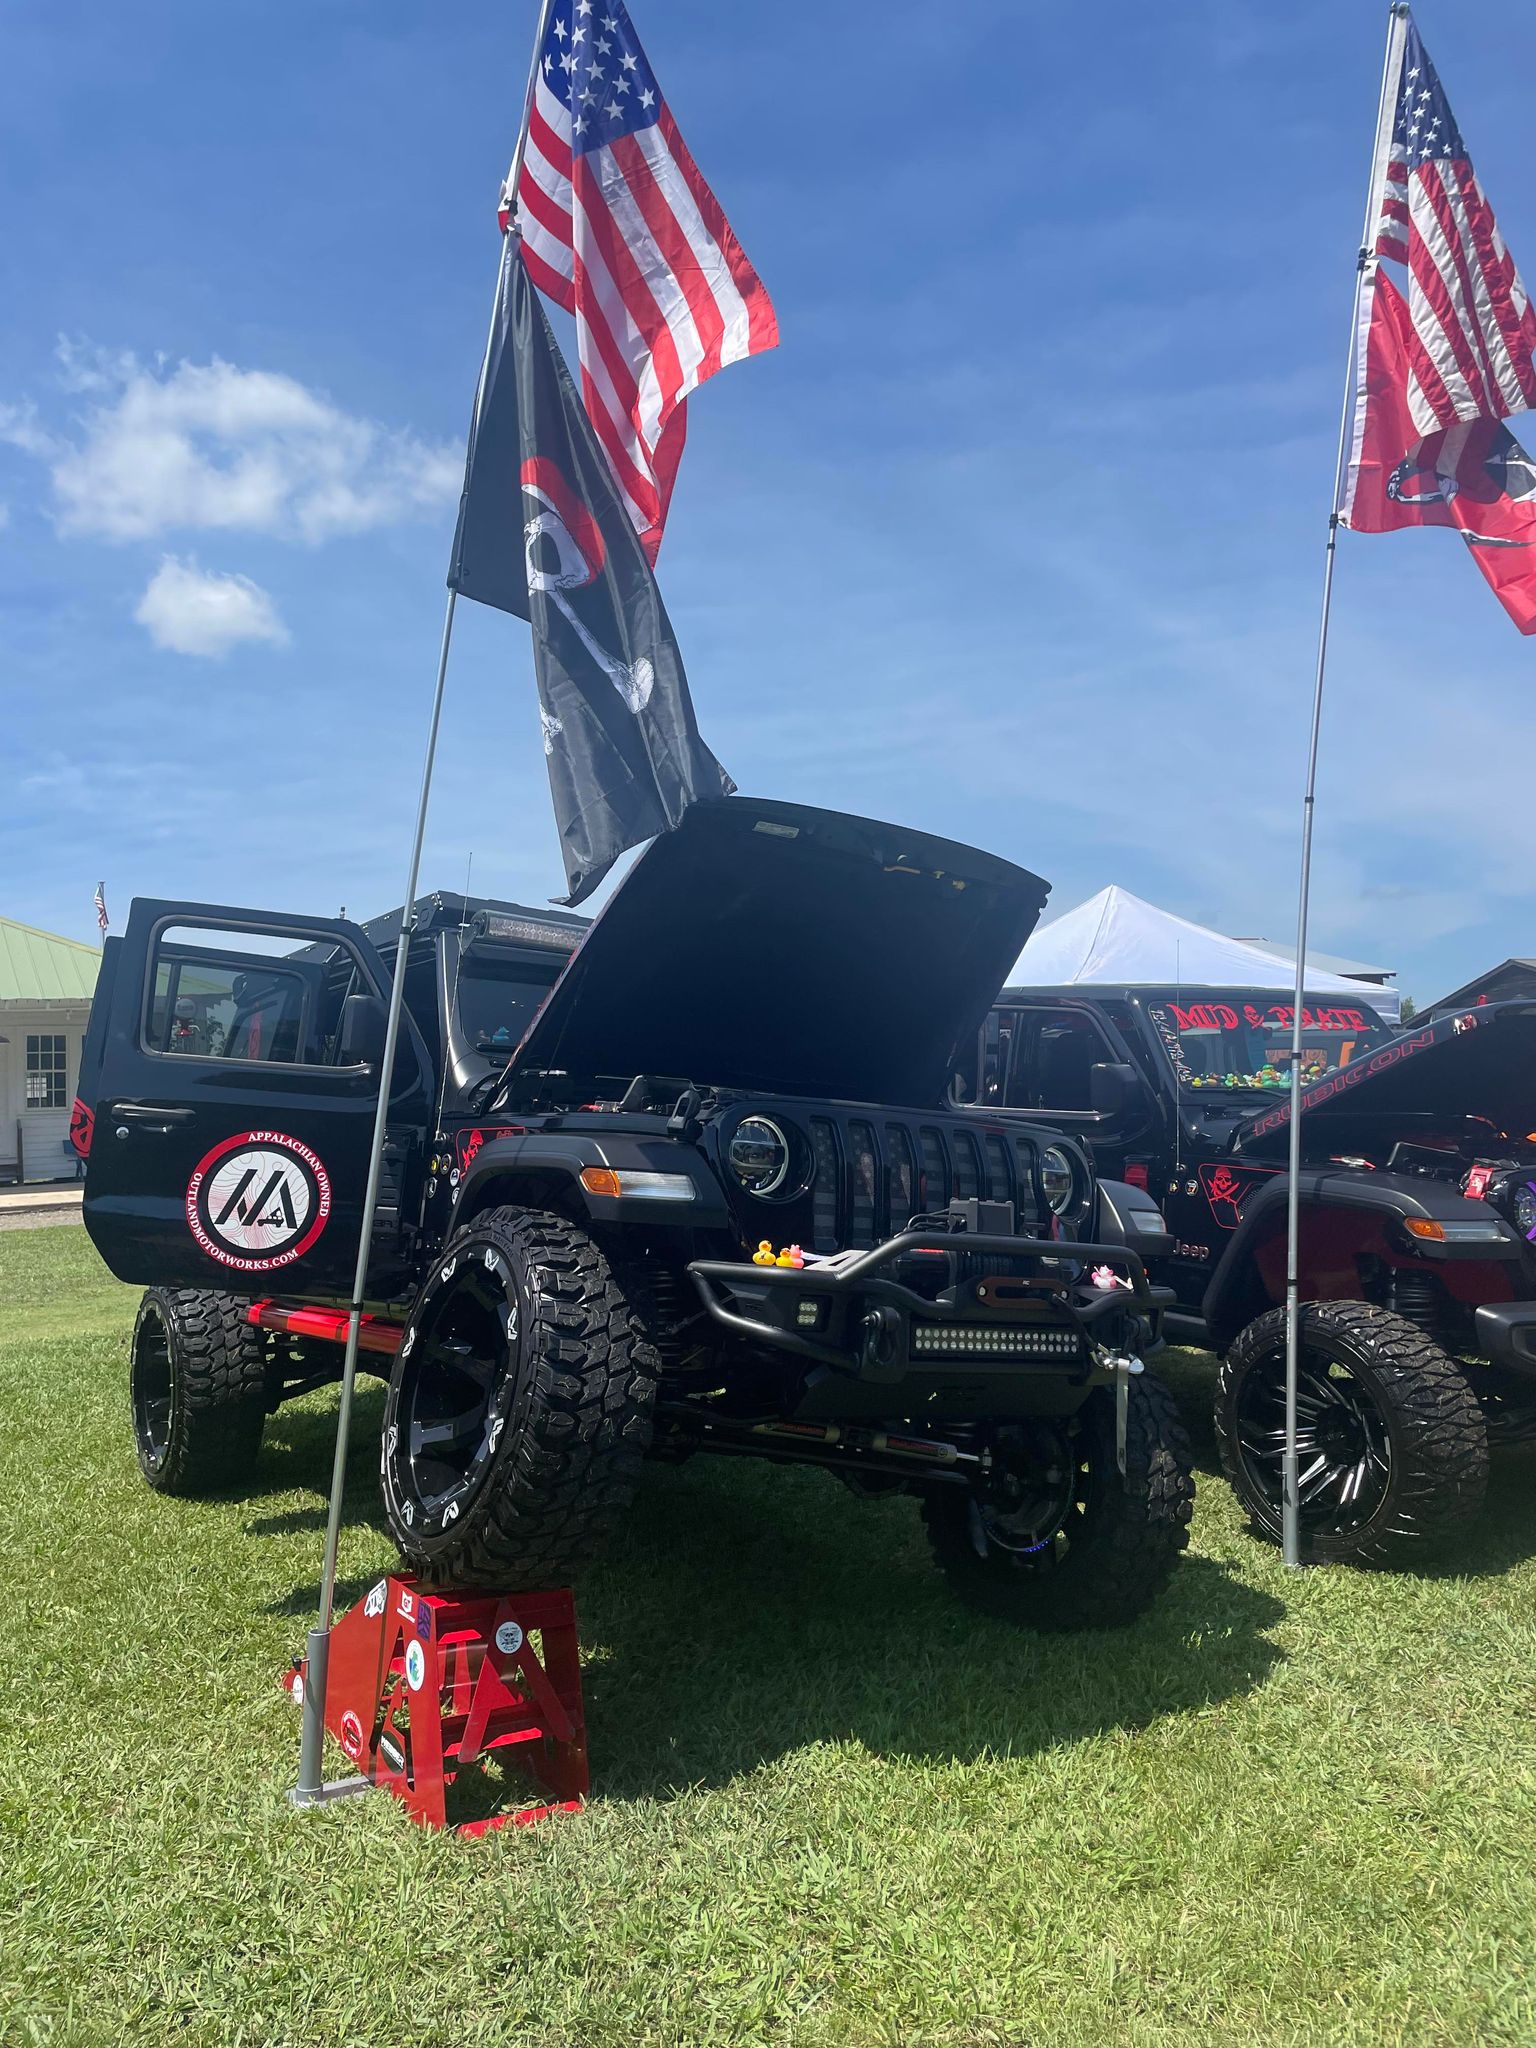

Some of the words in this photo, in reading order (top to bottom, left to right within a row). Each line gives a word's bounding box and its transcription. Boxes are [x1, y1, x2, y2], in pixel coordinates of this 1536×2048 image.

[1166, 1003, 1239, 1030] MUD
[1252, 1030, 1435, 1137] RUBICON
[248, 1132, 322, 1172] APPALACHIAN
[317, 1172, 330, 1217] OWNED
[187, 1172, 298, 1270] OUTLANDMOTORWORKS.COM
[1172, 1239, 1210, 1262] Jeep
